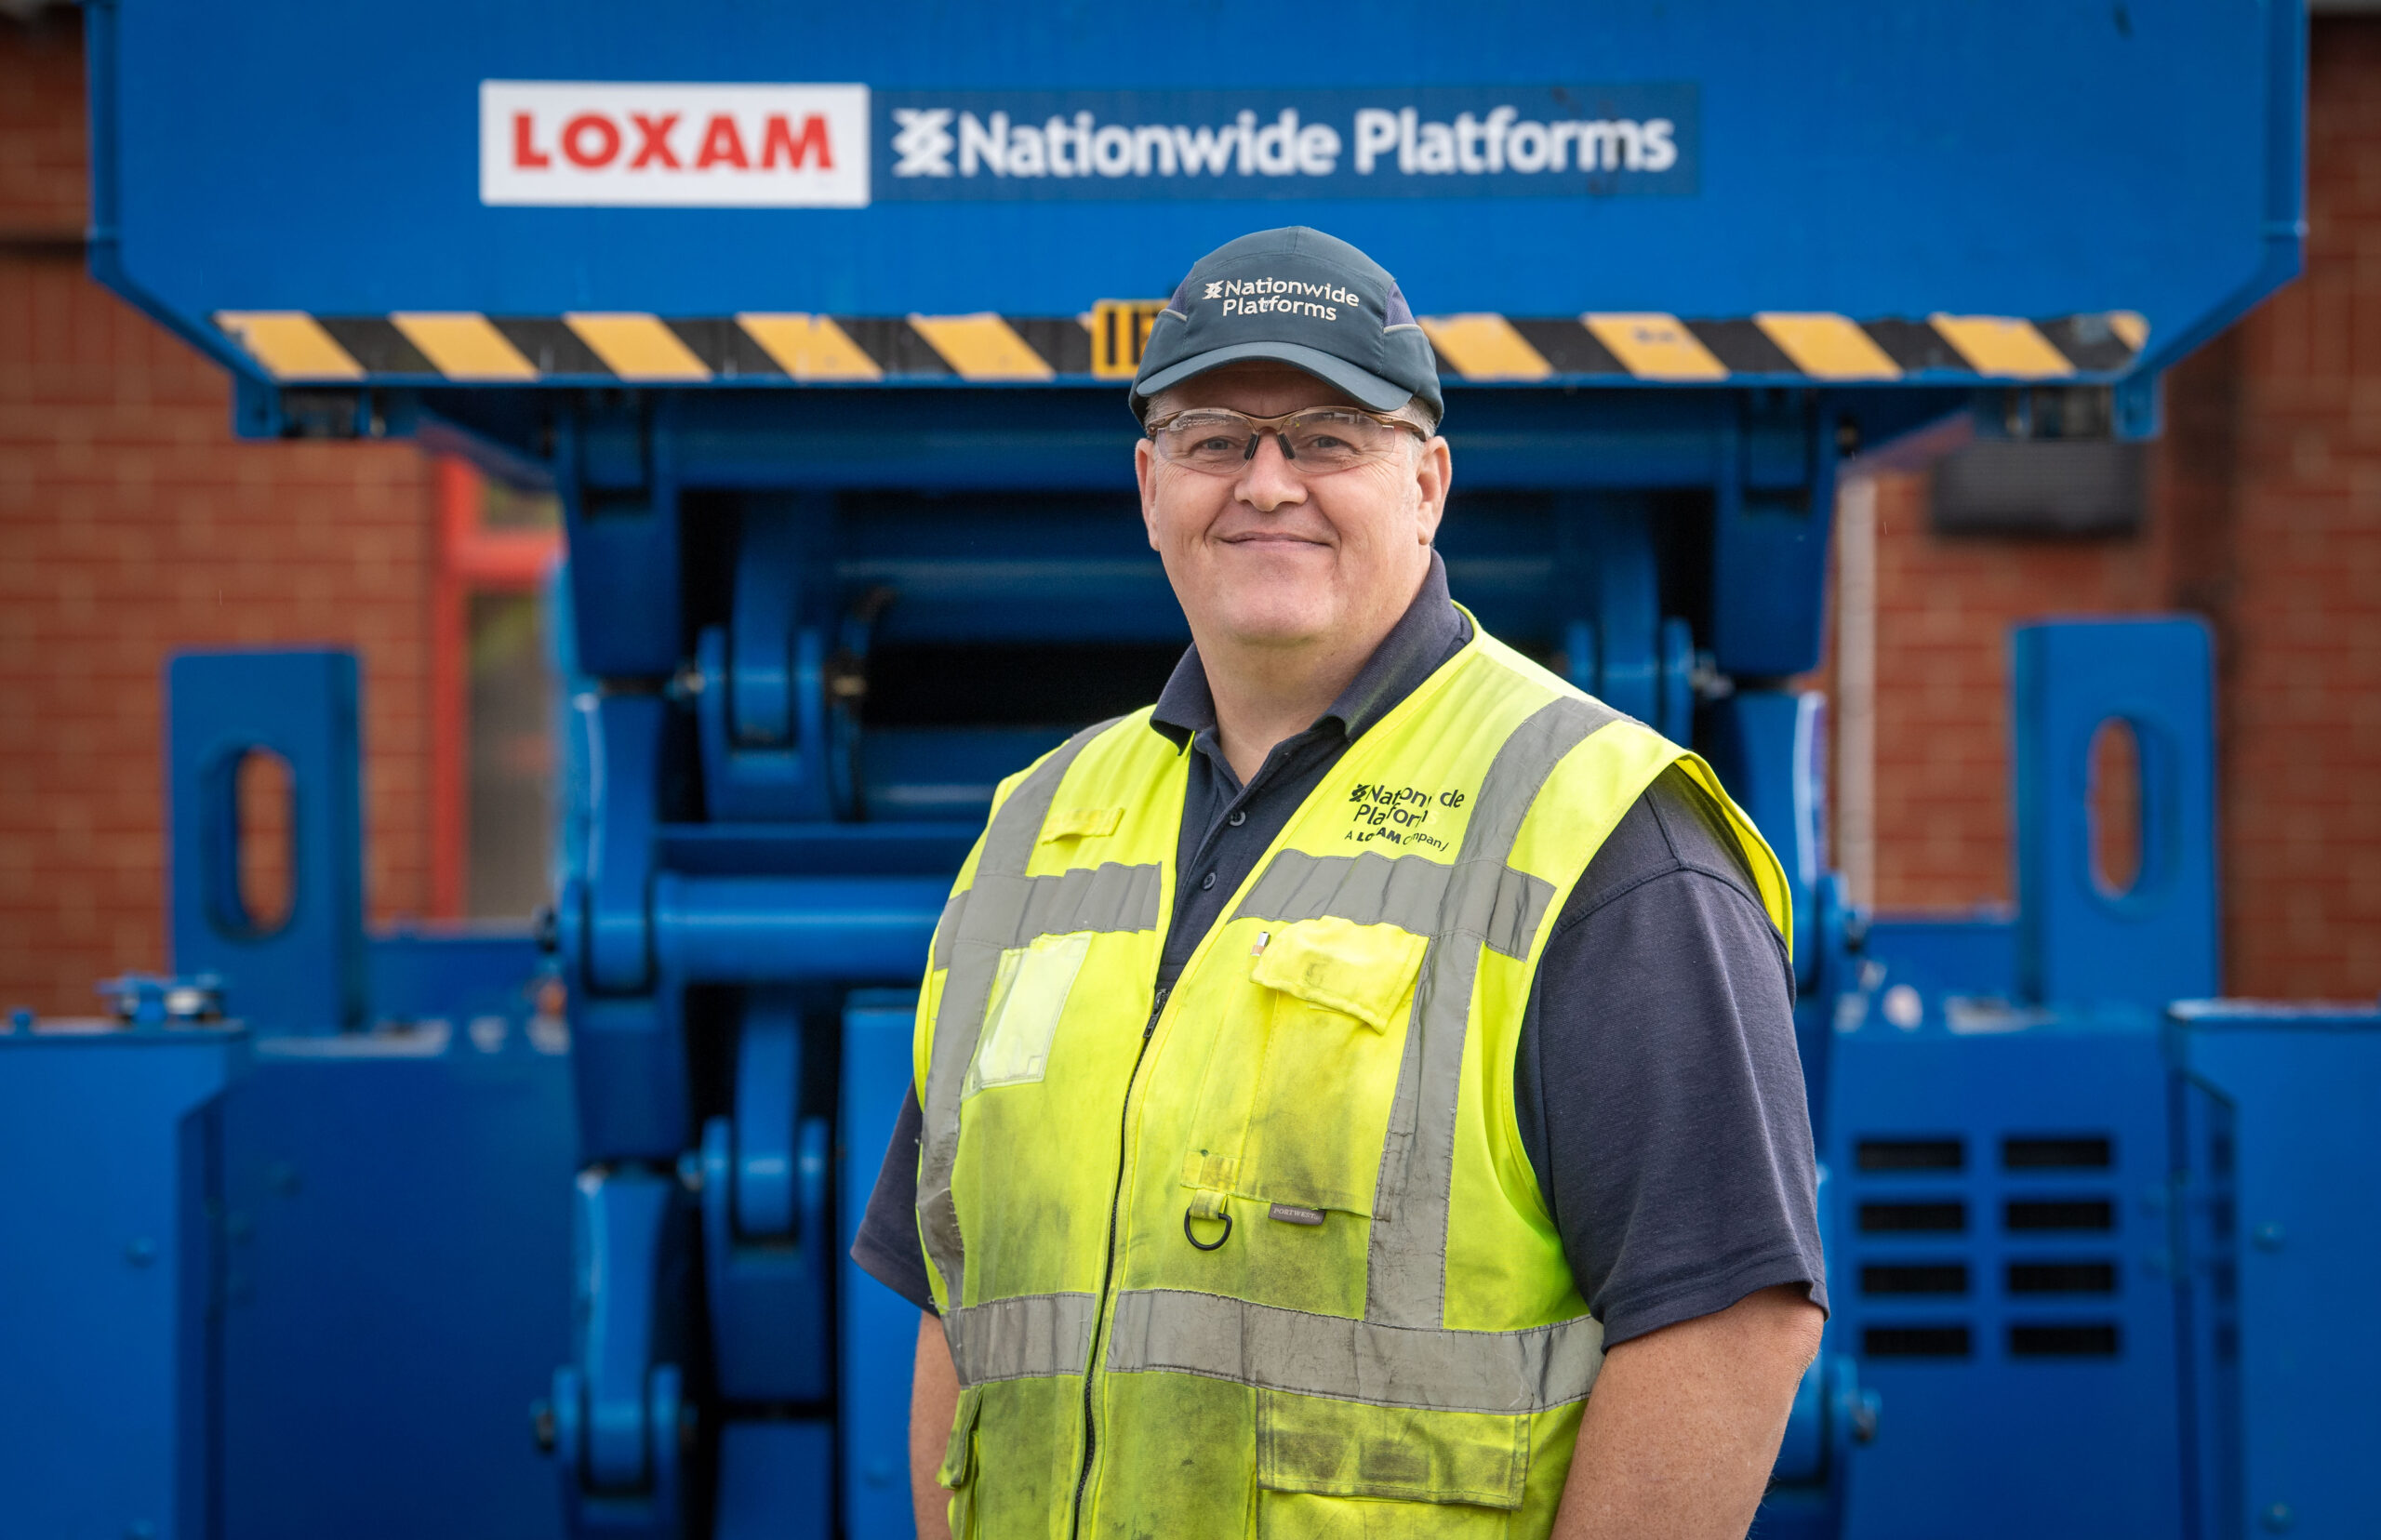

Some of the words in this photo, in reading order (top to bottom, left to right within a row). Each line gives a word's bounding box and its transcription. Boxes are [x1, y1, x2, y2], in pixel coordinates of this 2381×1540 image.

[512, 110, 835, 171] LOXAM
[959, 108, 1340, 177] Nationwide
[1354, 106, 1677, 174] Platforms
[1224, 277, 1360, 307] Nationwide
[1222, 295, 1337, 321] Platforms
[1345, 830, 1352, 840] A
[1273, 1207, 1315, 1219] PORTWEST
